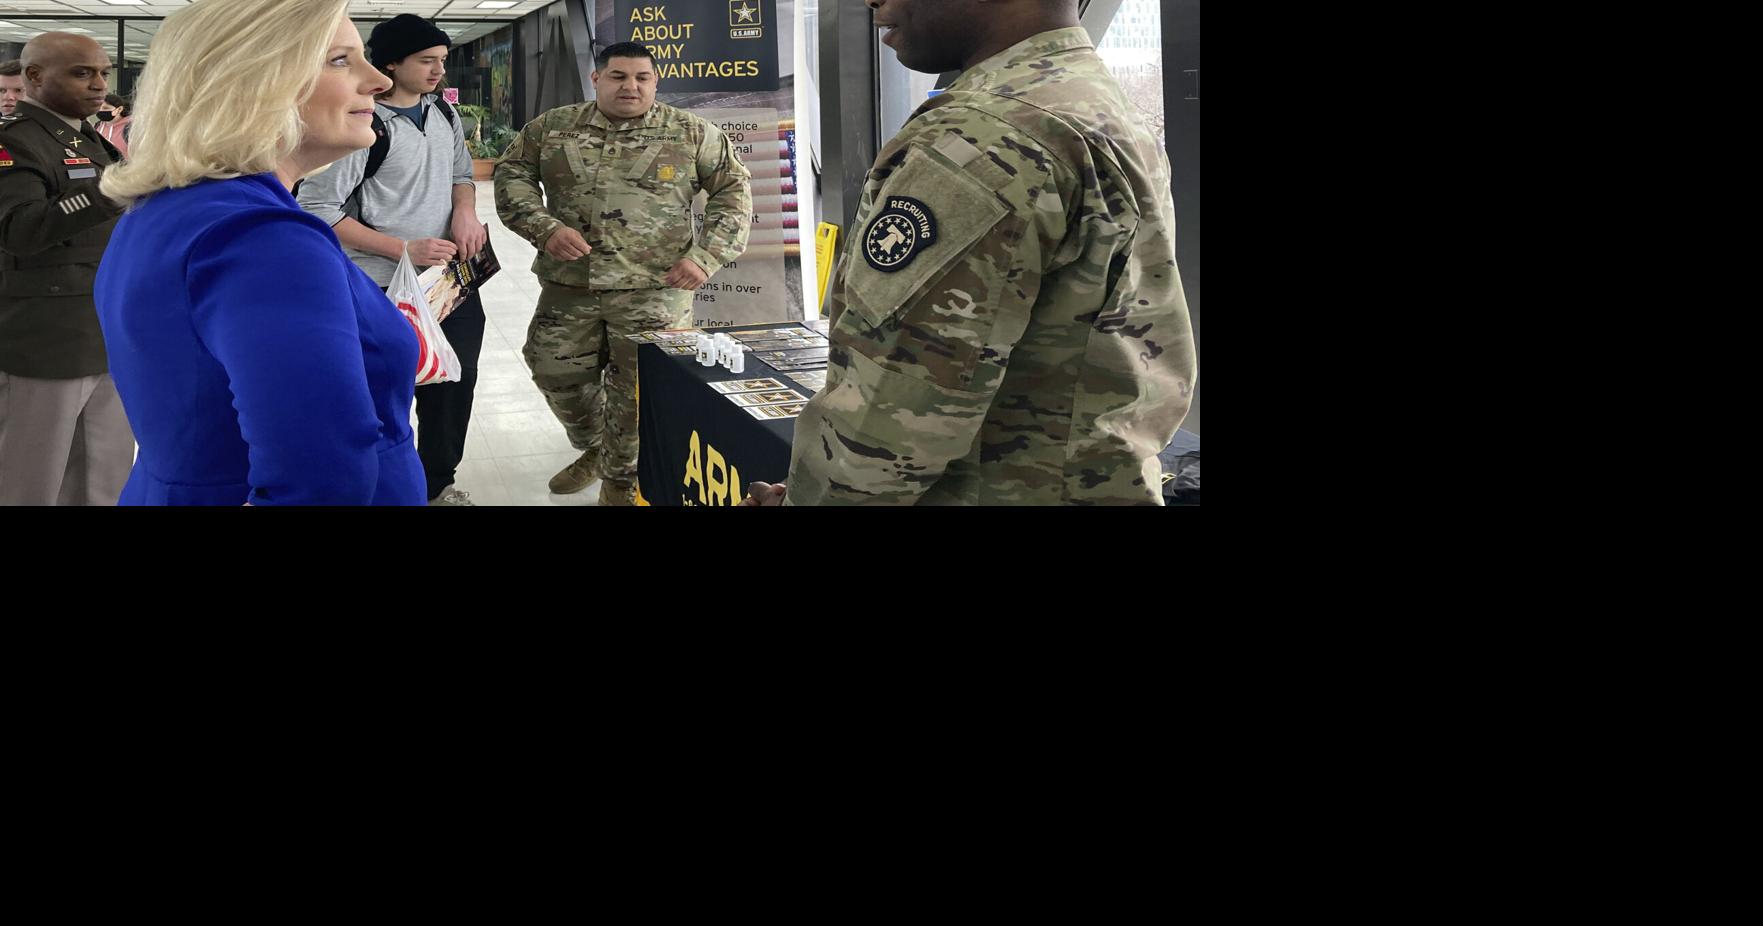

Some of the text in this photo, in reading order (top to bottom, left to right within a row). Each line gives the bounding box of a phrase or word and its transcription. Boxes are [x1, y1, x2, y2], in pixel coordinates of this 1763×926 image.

[630, 6, 666, 23] ASK
[631, 24, 694, 42] ABOUT
[646, 44, 685, 59] RMY
[656, 60, 759, 79] VANTAGES
[721, 121, 758, 131] choice
[891, 200, 931, 239] RECRUITING
[722, 282, 732, 292] in
[735, 284, 762, 294] over
